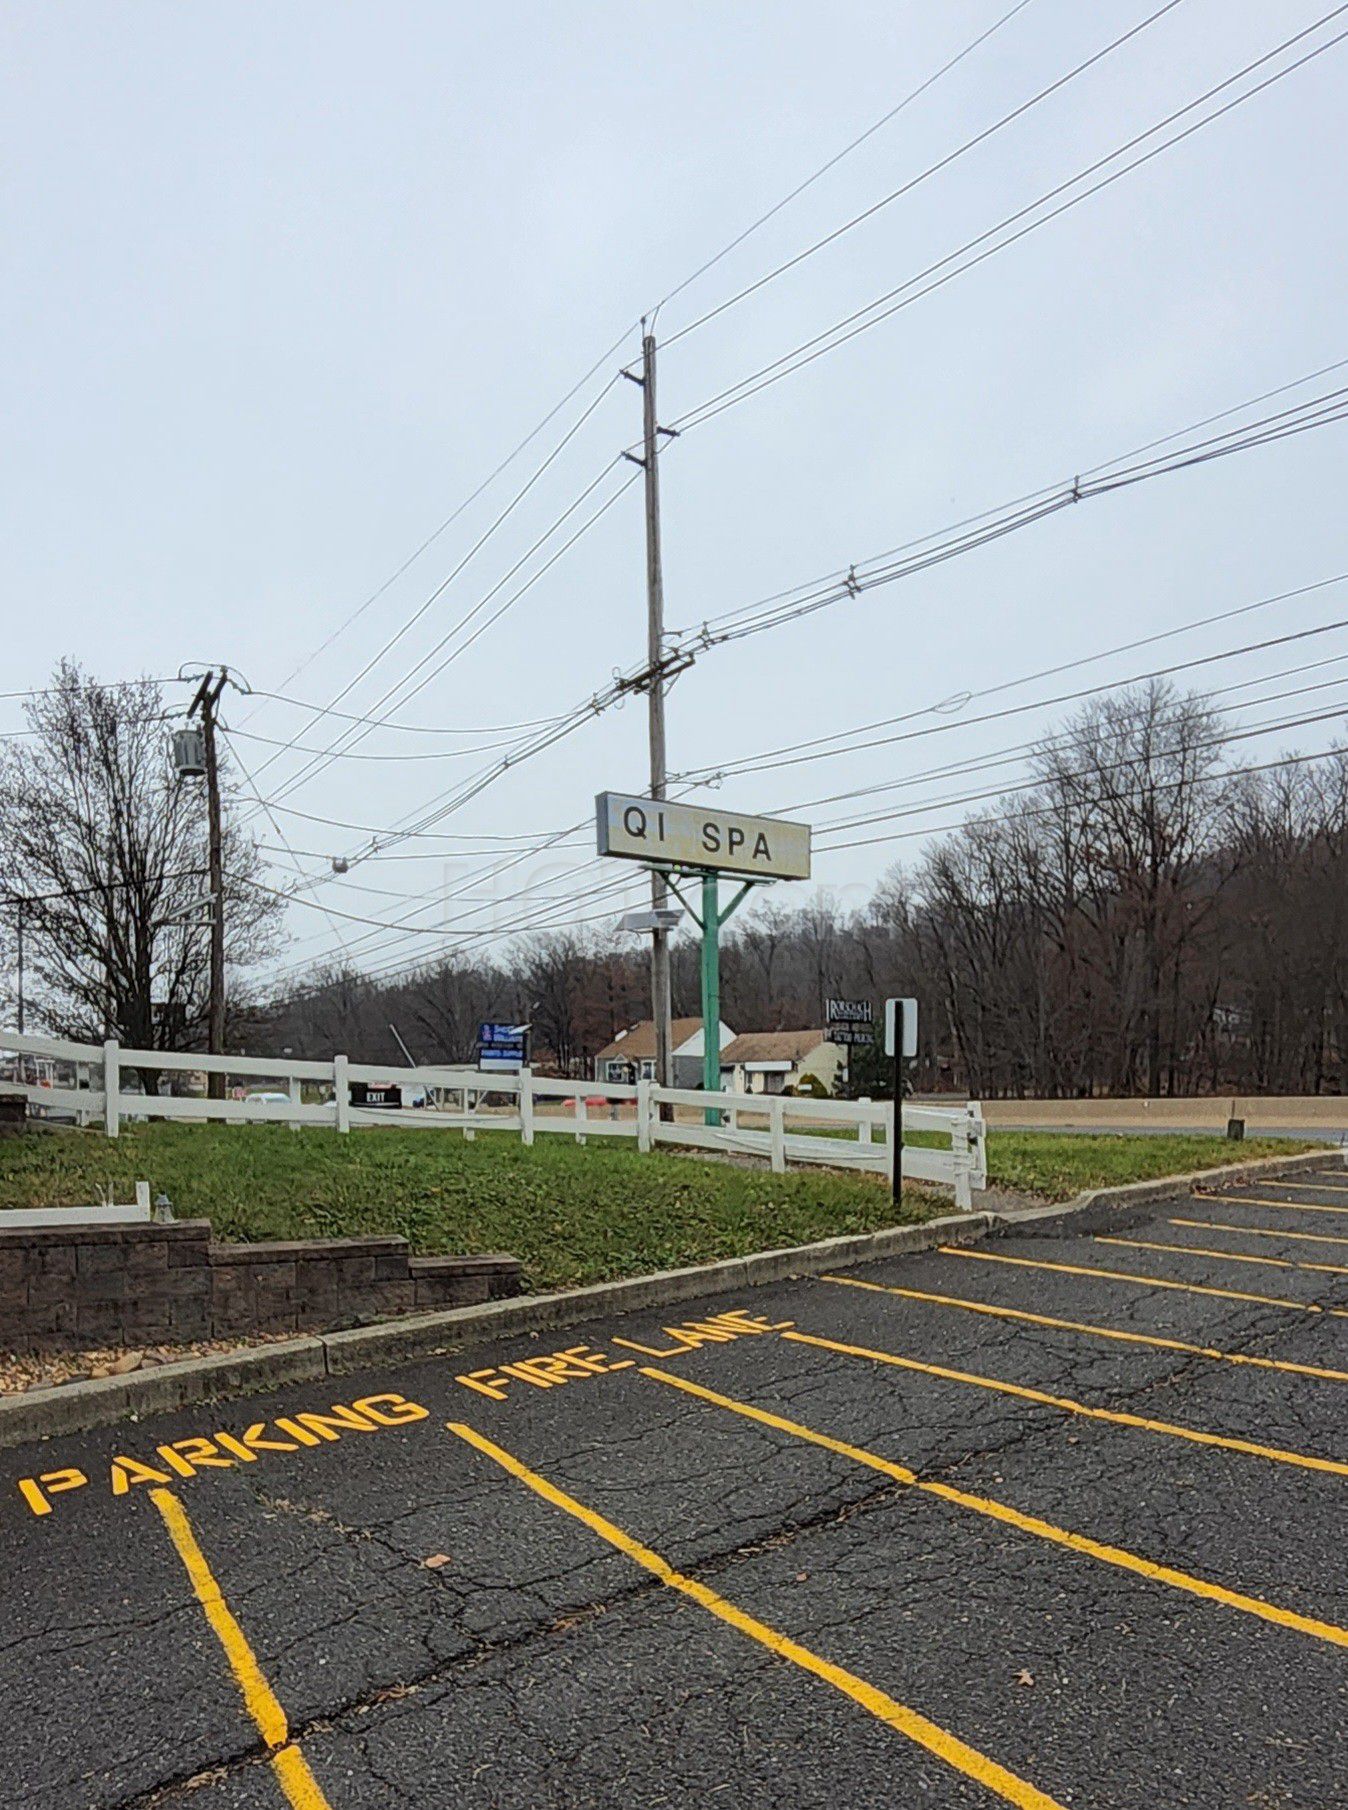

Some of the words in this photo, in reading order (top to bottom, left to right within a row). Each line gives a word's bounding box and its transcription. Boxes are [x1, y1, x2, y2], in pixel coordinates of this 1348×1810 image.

[623, 806, 665, 842] QI
[702, 822, 772, 862] SPA
[366, 1091, 386, 1103] EXIT
[18, 1393, 430, 1516] PARKING
[455, 1345, 637, 1400] FIRE
[611, 1309, 795, 1358] LANE
